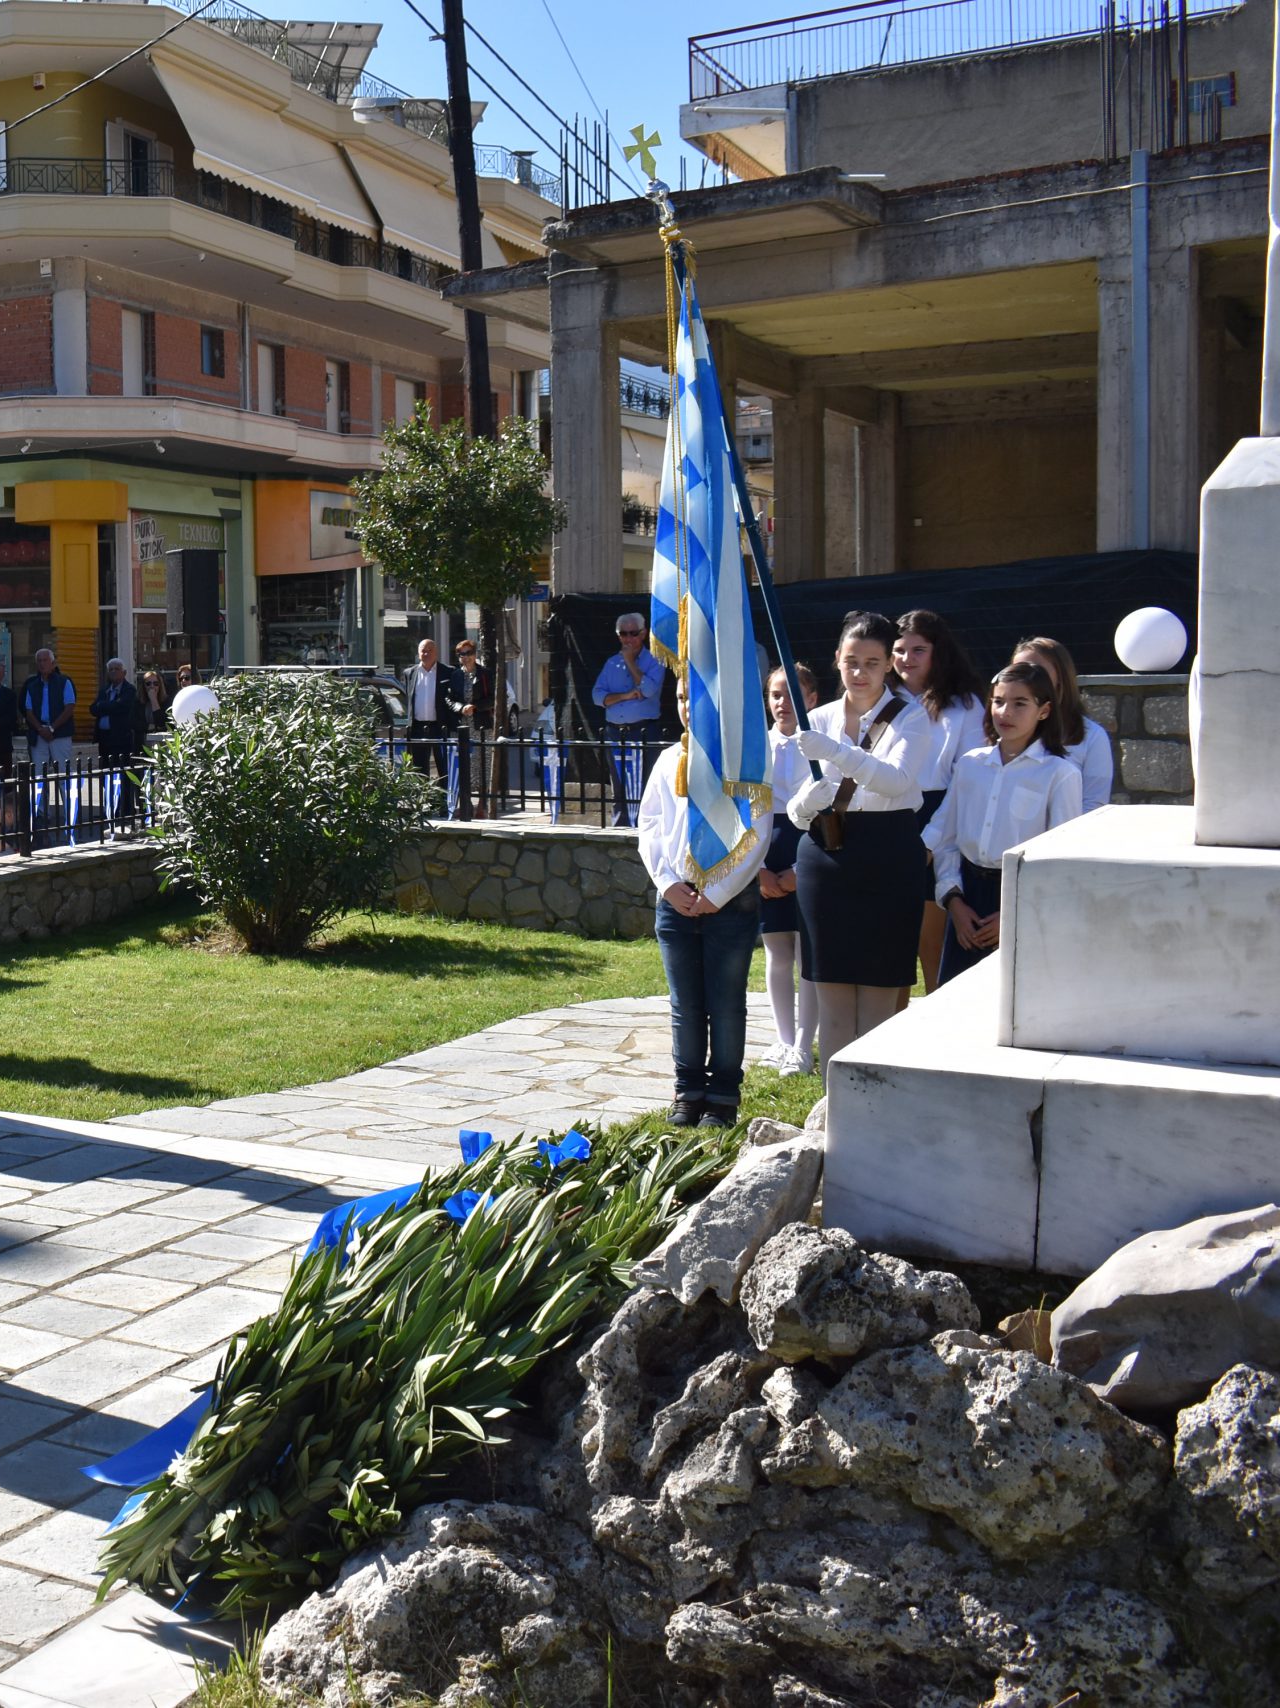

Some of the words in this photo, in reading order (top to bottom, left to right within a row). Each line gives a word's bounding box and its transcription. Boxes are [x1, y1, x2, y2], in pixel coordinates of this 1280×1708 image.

[134, 519, 156, 539] DURO
[178, 522, 220, 543] ΤΕΧΝΙΚΟ
[140, 539, 163, 560] STICK
